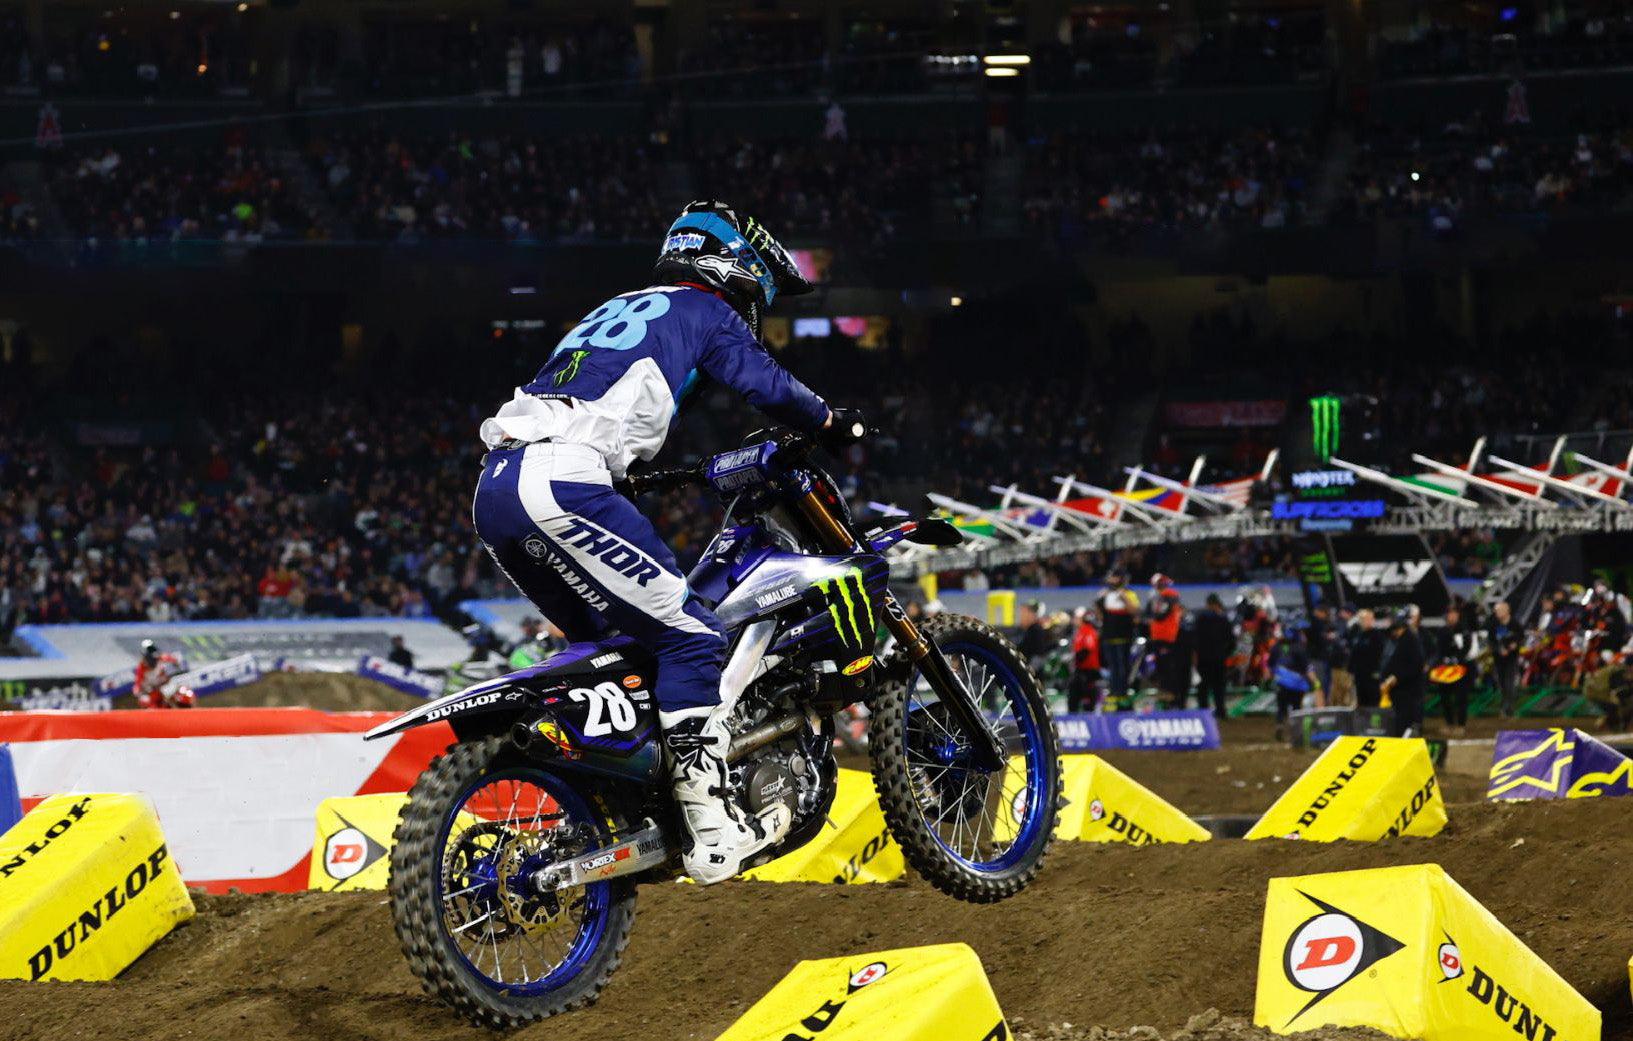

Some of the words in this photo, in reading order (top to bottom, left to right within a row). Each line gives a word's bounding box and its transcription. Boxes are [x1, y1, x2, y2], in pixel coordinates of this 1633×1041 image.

[553, 293, 671, 355] 28
[556, 518, 662, 587] THOR
[547, 552, 609, 613] YAMAHA
[1338, 560, 1434, 587] FLY
[755, 584, 798, 608] YAMALUBE
[589, 651, 624, 669] YAMAHA
[426, 690, 502, 722] DUNLOP
[568, 682, 637, 737] 28
[1138, 718, 1206, 738] YAMAHA
[1299, 738, 1377, 828] DUNLOP
[580, 852, 616, 874] VORTEX
[28, 843, 168, 981] DUNLOP
[1296, 936, 1356, 971] D
